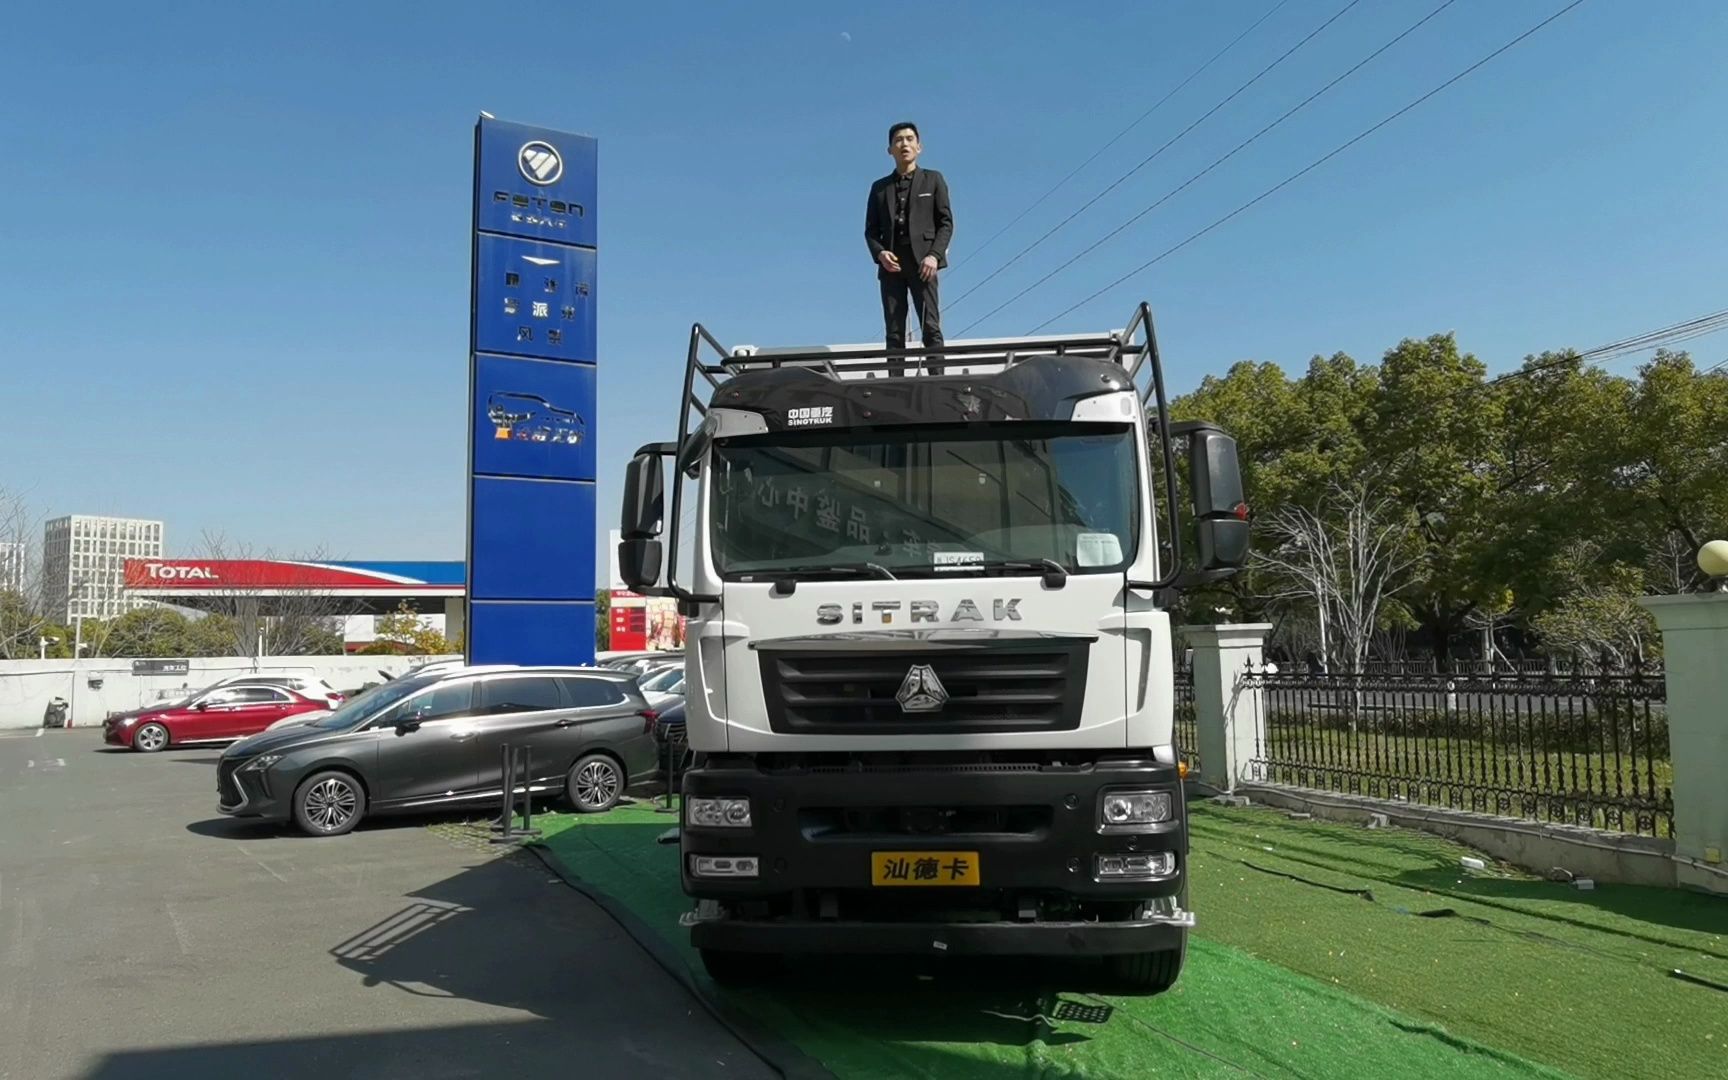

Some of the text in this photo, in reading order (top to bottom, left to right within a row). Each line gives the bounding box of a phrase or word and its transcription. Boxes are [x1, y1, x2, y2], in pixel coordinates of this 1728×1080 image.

[788, 417, 832, 426] SINOTRUK
[145, 563, 219, 579] TOTAL
[816, 599, 1022, 625] SITRAK
[883, 857, 969, 880] 汕德卡
